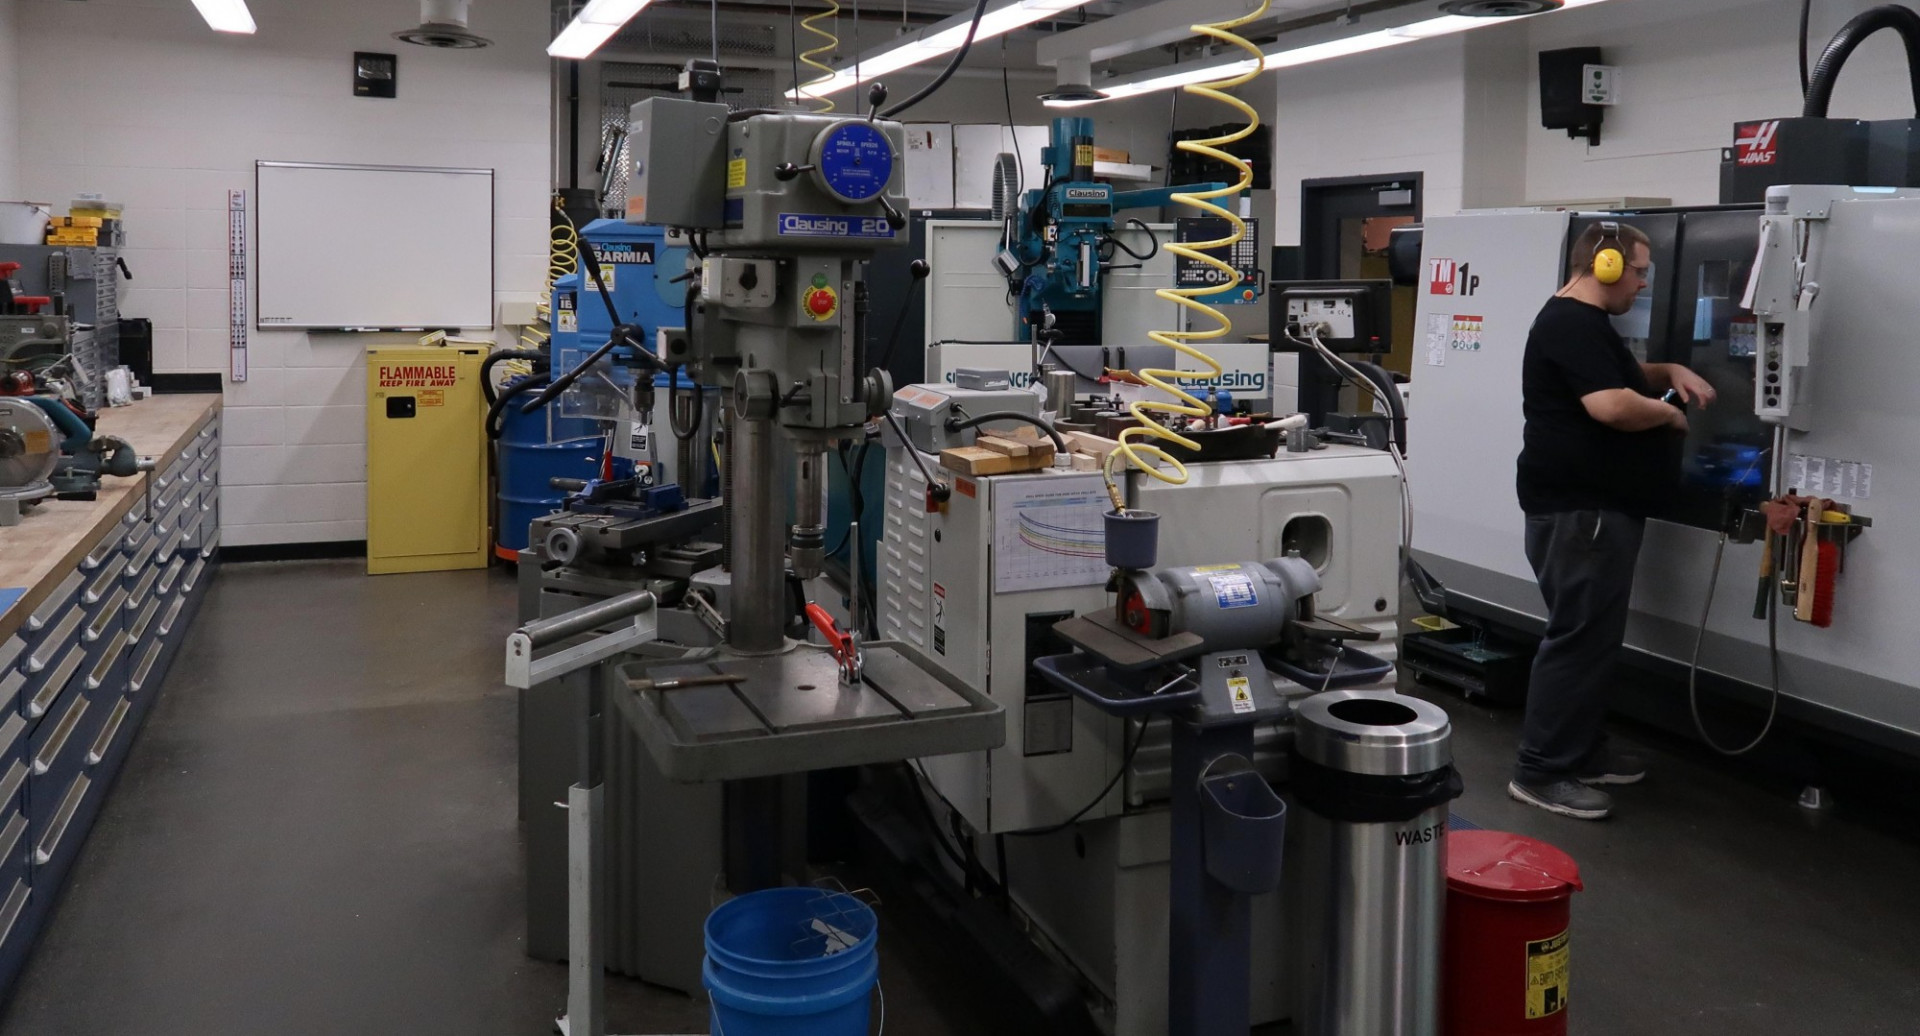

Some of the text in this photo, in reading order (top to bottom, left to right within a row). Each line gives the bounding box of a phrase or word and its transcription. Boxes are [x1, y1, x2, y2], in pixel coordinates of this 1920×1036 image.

[1738, 151, 1776, 164] HAAS
[1069, 189, 1106, 198] Clausing
[784, 216, 890, 235] Clausing 20
[601, 243, 632, 252] Clausing
[1429, 258, 1453, 283] TM
[379, 366, 456, 380] FLAMMABLE
[1177, 369, 1265, 391] Clausing
[379, 379, 456, 388] KEEP FIRE AWAY
[1395, 821, 1445, 846] WASTE
